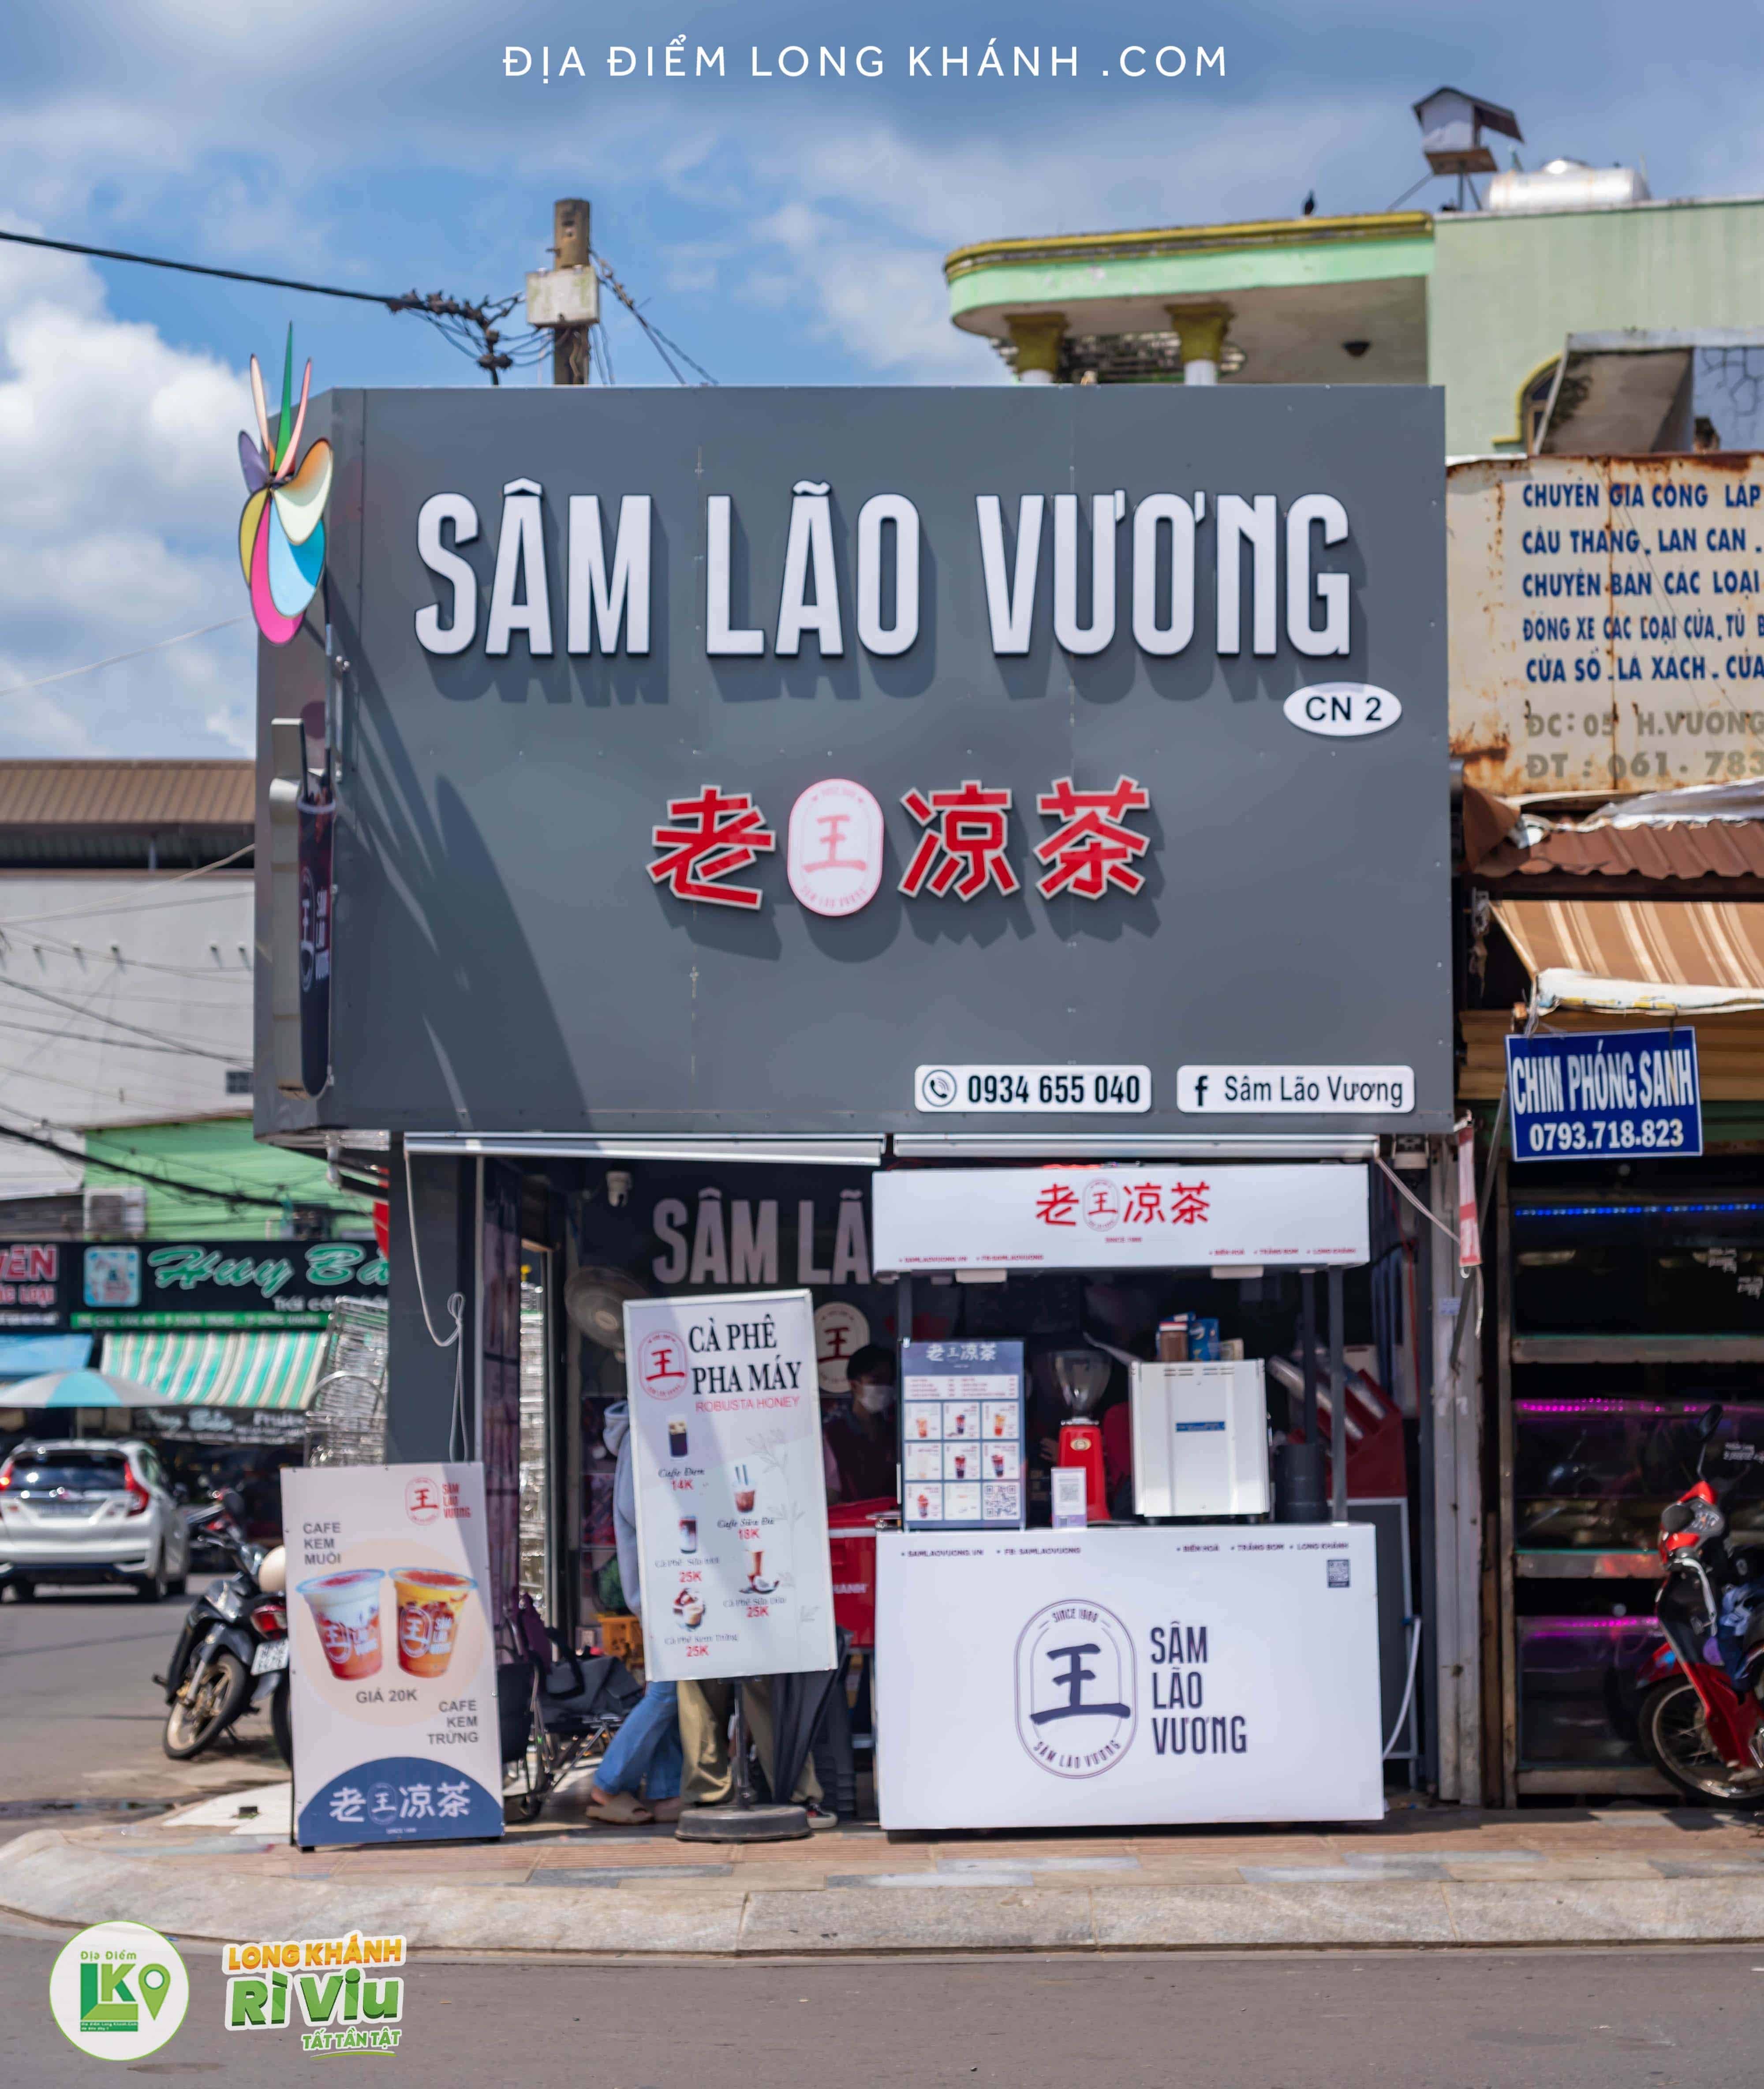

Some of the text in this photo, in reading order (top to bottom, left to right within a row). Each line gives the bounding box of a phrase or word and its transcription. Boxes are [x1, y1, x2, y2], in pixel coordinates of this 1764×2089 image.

[1609, 483, 1644, 507] GIA
[1658, 528, 1697, 553] LAN
[415, 476, 1352, 657] SÂM LÃO VƯƠNG
[1713, 570, 1760, 599] LOẠI
[1640, 614, 1676, 645] LOẠI
[1304, 697, 1382, 722] CN 2
[968, 1075, 1141, 1104] 0934 655 040
[1224, 1075, 1273, 1101] Sâm
[1281, 1076, 1319, 1101] Lão
[1327, 1075, 1404, 1107] Vương
[1512, 1039, 1694, 1114] CHIM PHÓNG SANH
[1529, 1118, 1685, 1151] 0793.718.823
[652, 1186, 872, 1284] SÂM LÃ
[147, 1245, 295, 1298] Huy
[689, 1313, 777, 1353] CÀ PHÊ
[691, 1353, 802, 1395] PHA MÁY
[695, 1396, 800, 1413] ROBUSTA HONEY
[303, 1522, 340, 1534] CAFE
[304, 1538, 335, 1549] KEM
[679, 1570, 703, 1582] 25K
[747, 1606, 769, 1618] 25K
[1052, 1608, 1076, 1622] SINCE
[686, 1645, 709, 1657] 25K
[1150, 1621, 1207, 1664] SÂM
[356, 1688, 417, 1703] GIÁ 20K
[1030, 1644, 1131, 1725] 王
[1152, 1667, 1202, 1709] LÃO
[438, 1700, 477, 1712] CAFE
[446, 1715, 478, 1727] KEM
[1152, 1716, 1247, 1755] VƯƠNG
